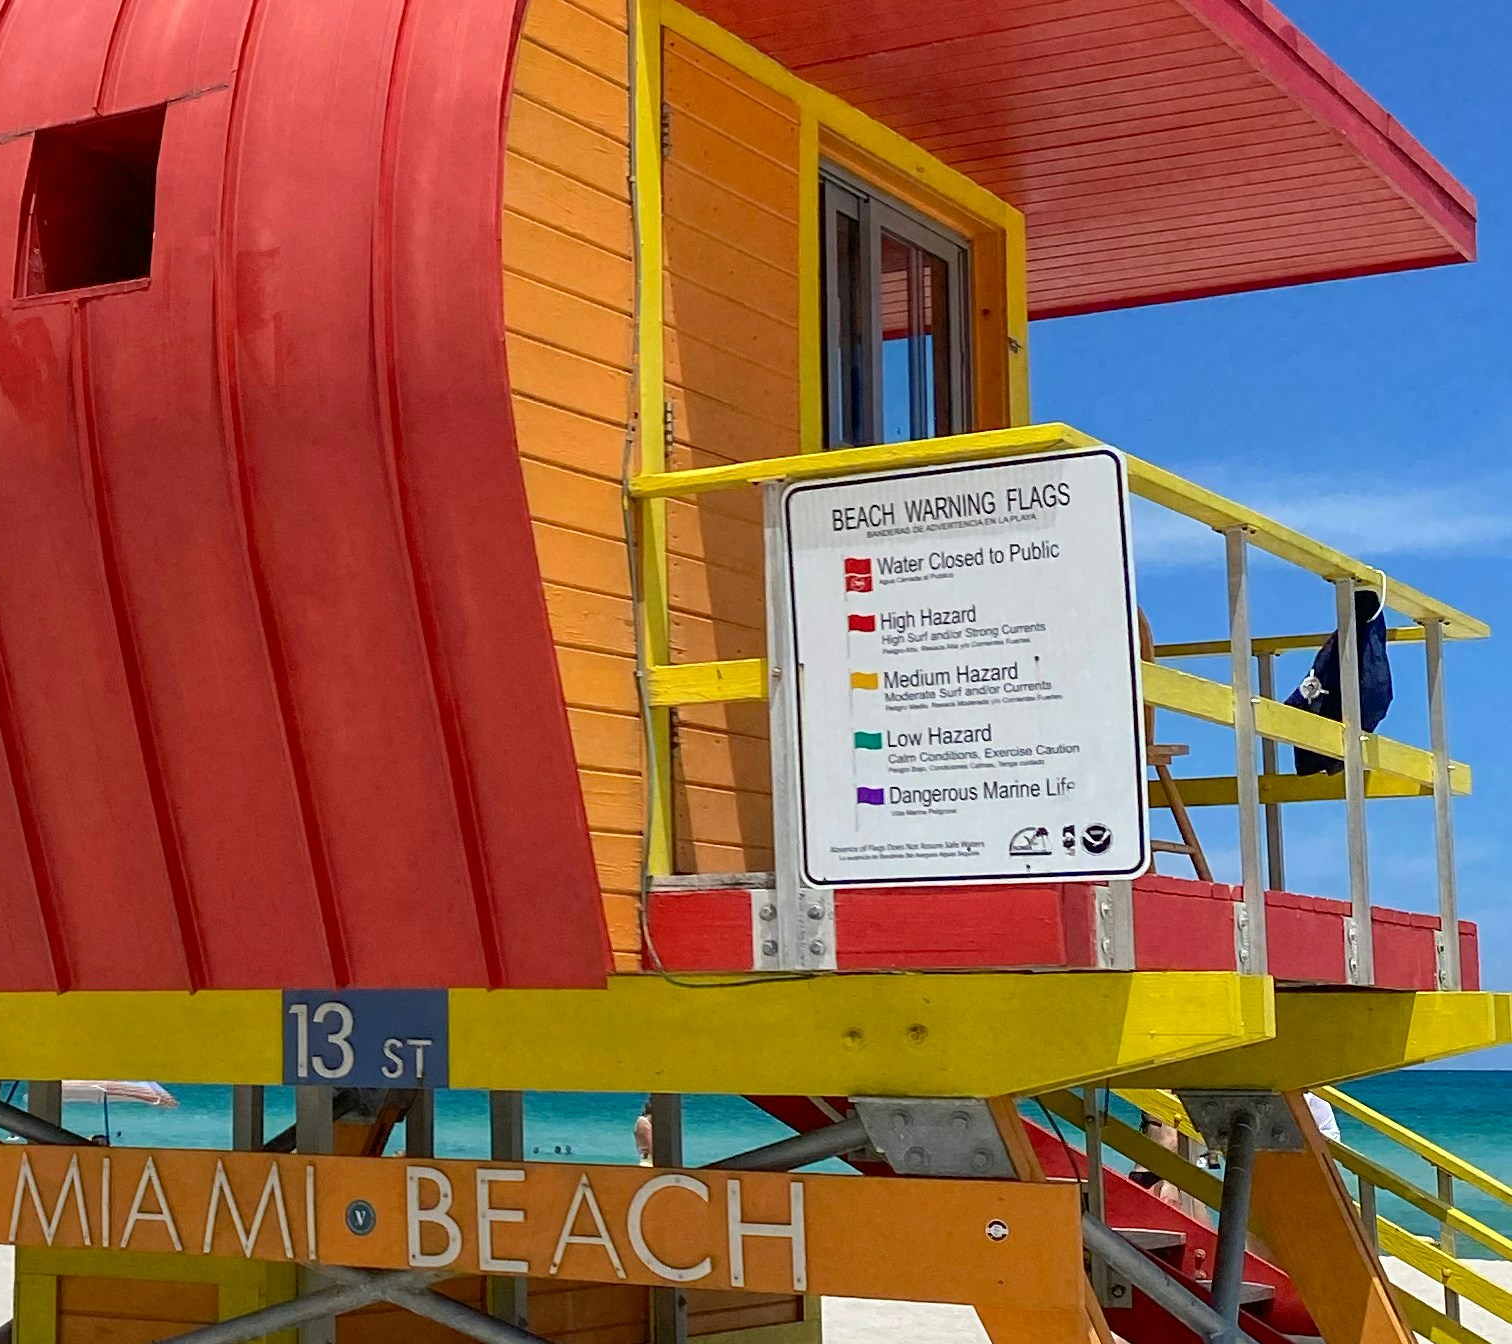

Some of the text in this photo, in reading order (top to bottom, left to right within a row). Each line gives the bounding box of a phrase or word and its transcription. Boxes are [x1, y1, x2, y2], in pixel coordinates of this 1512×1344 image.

[832, 483, 1070, 531] BEACH WARNING FLAGS
[913, 525, 923, 533] DE
[877, 540, 1060, 575] Water Closed to Public
[881, 604, 976, 633] High Hazard
[881, 623, 1046, 646] High Surf and/or Strong Currents
[884, 662, 1018, 689] Medium Hazard
[885, 681, 1052, 702] Moderate Surf and/or Currents
[887, 724, 992, 747] Low Hazard
[888, 744, 1080, 764] Calm Conditions, Exercise Caution
[889, 777, 1076, 807] Dangerous Marine Life
[289, 1002, 432, 1080] 13 ST
[8, 1151, 808, 1291] MIAMI BEACH
